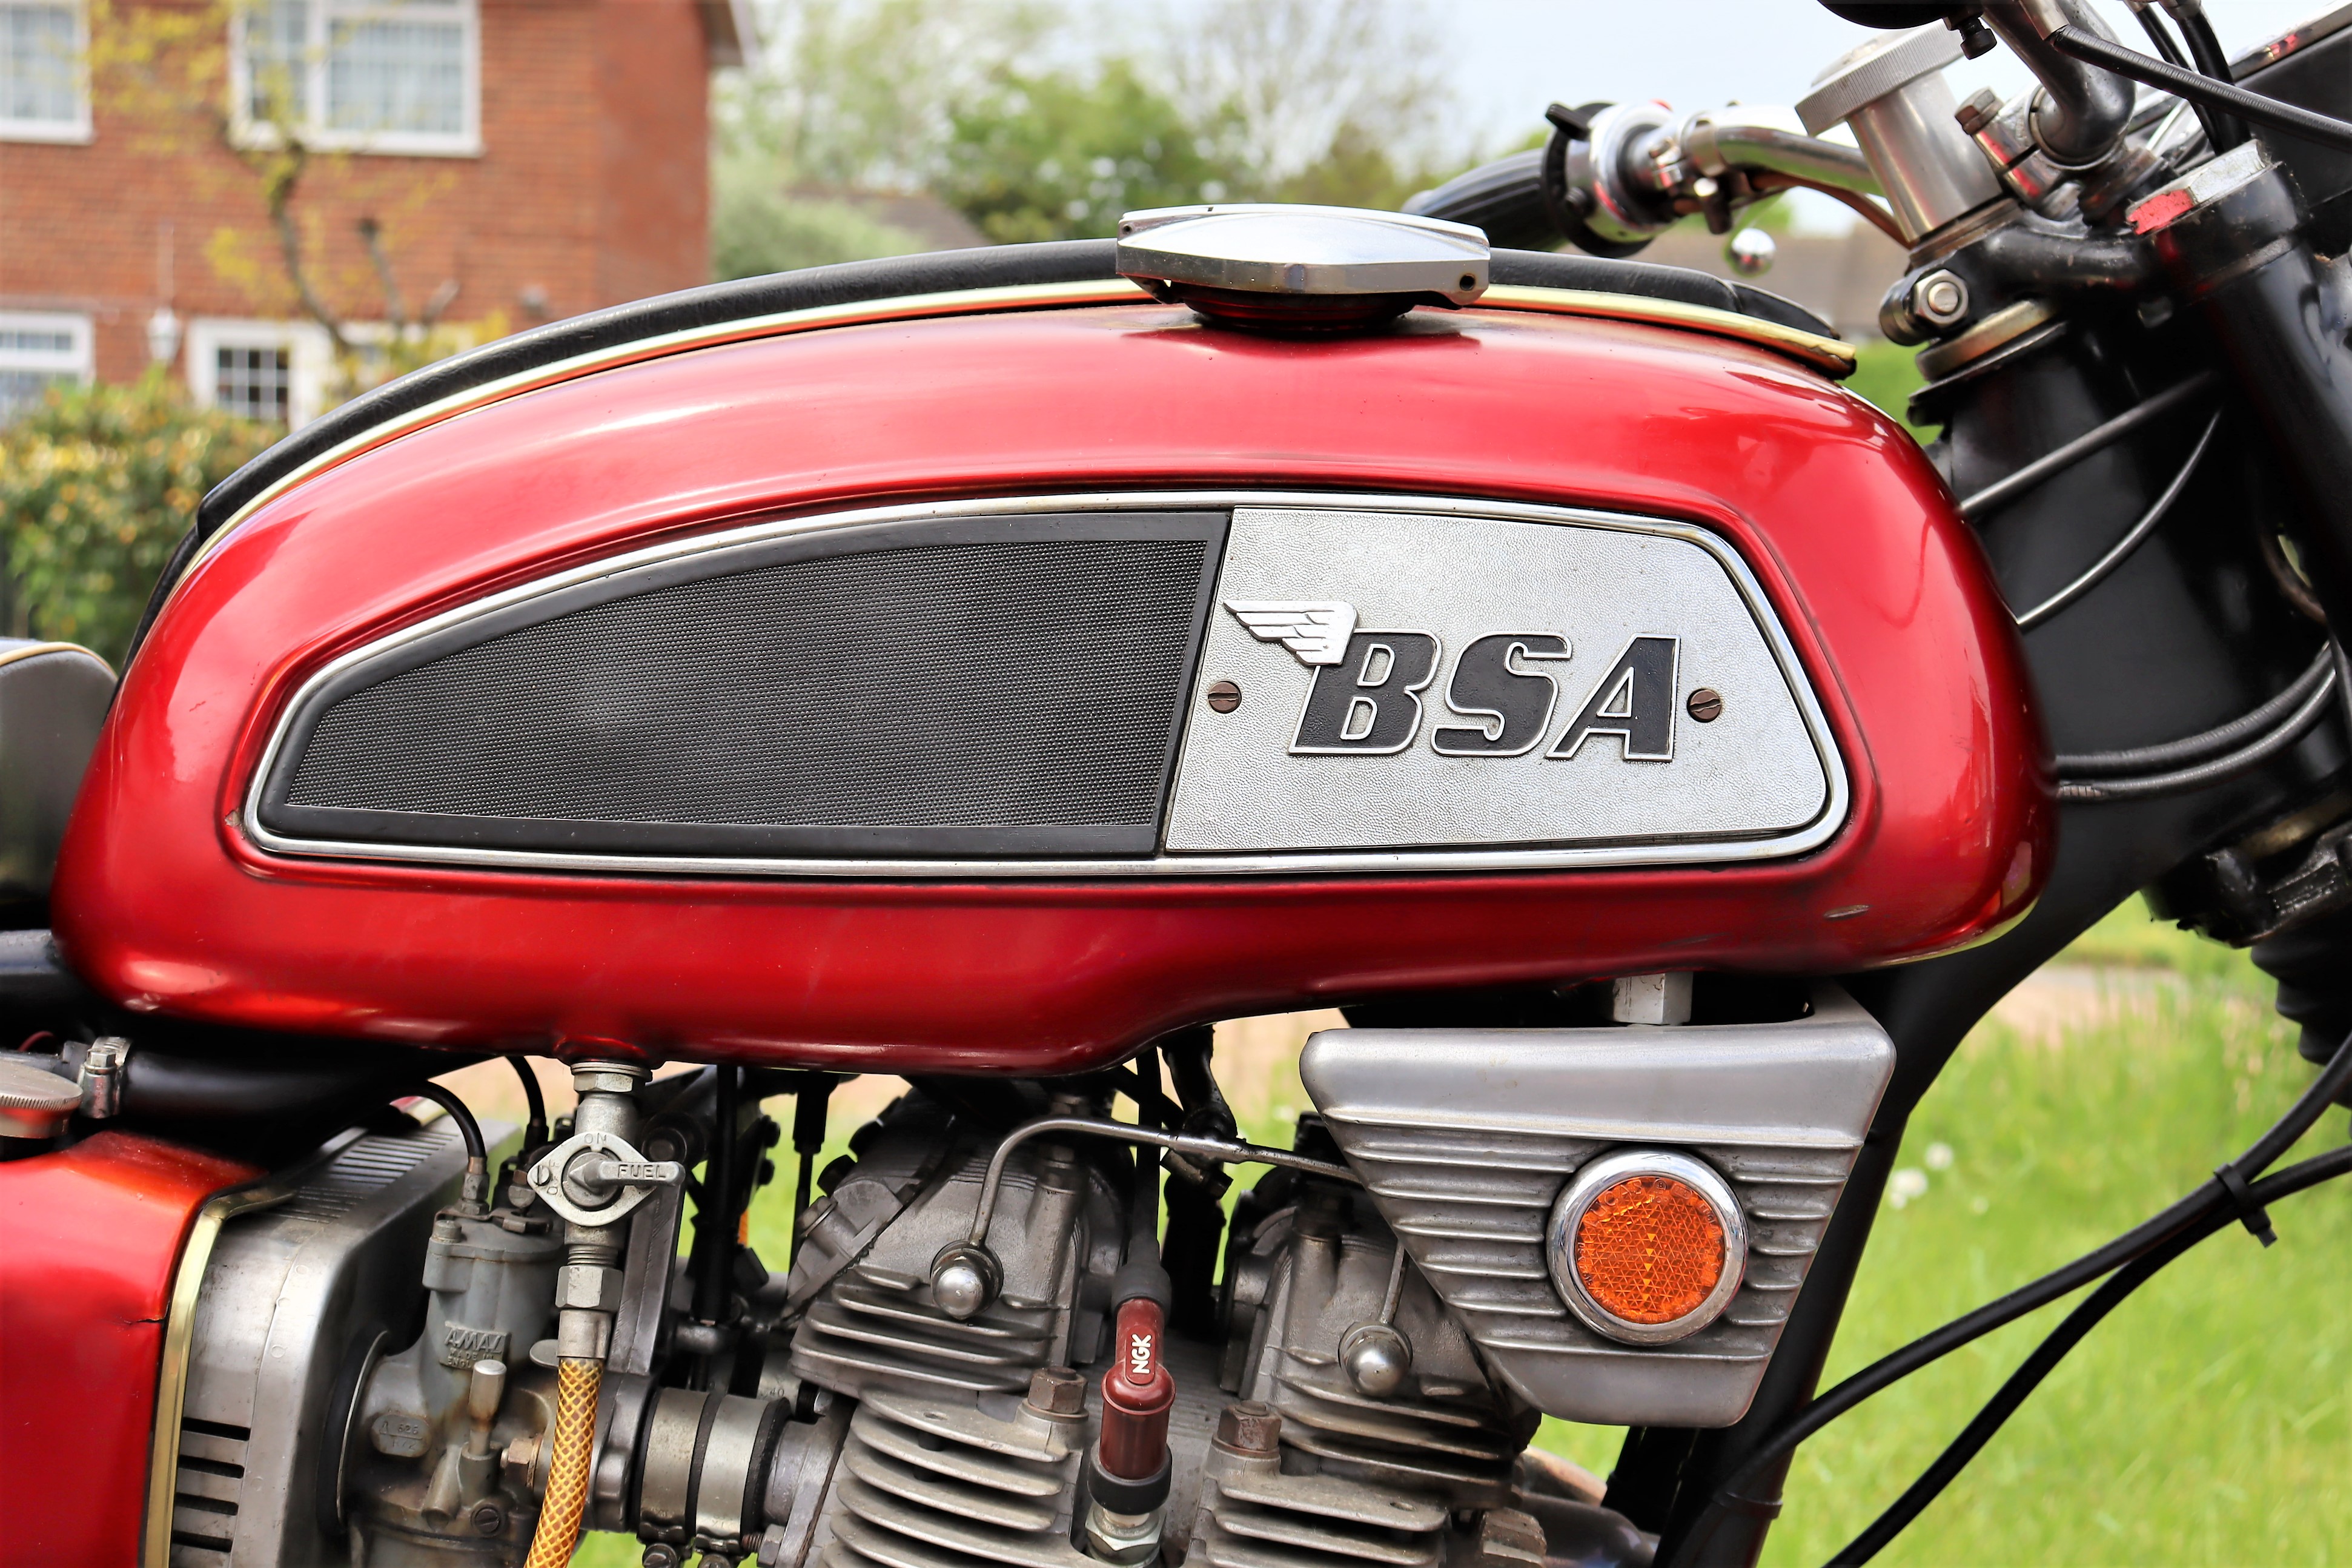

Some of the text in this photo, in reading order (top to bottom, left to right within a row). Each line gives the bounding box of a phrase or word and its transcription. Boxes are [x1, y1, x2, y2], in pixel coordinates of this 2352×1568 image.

[1288, 627, 1682, 762] BSA
[583, 1132, 607, 1145] ON
[617, 1164, 666, 1179] FUEL
[444, 1327, 502, 1354] AMAL
[450, 1348, 478, 1361] MADE
[1131, 1334, 1153, 1374] NGK
[448, 1356, 472, 1369] ENGL
